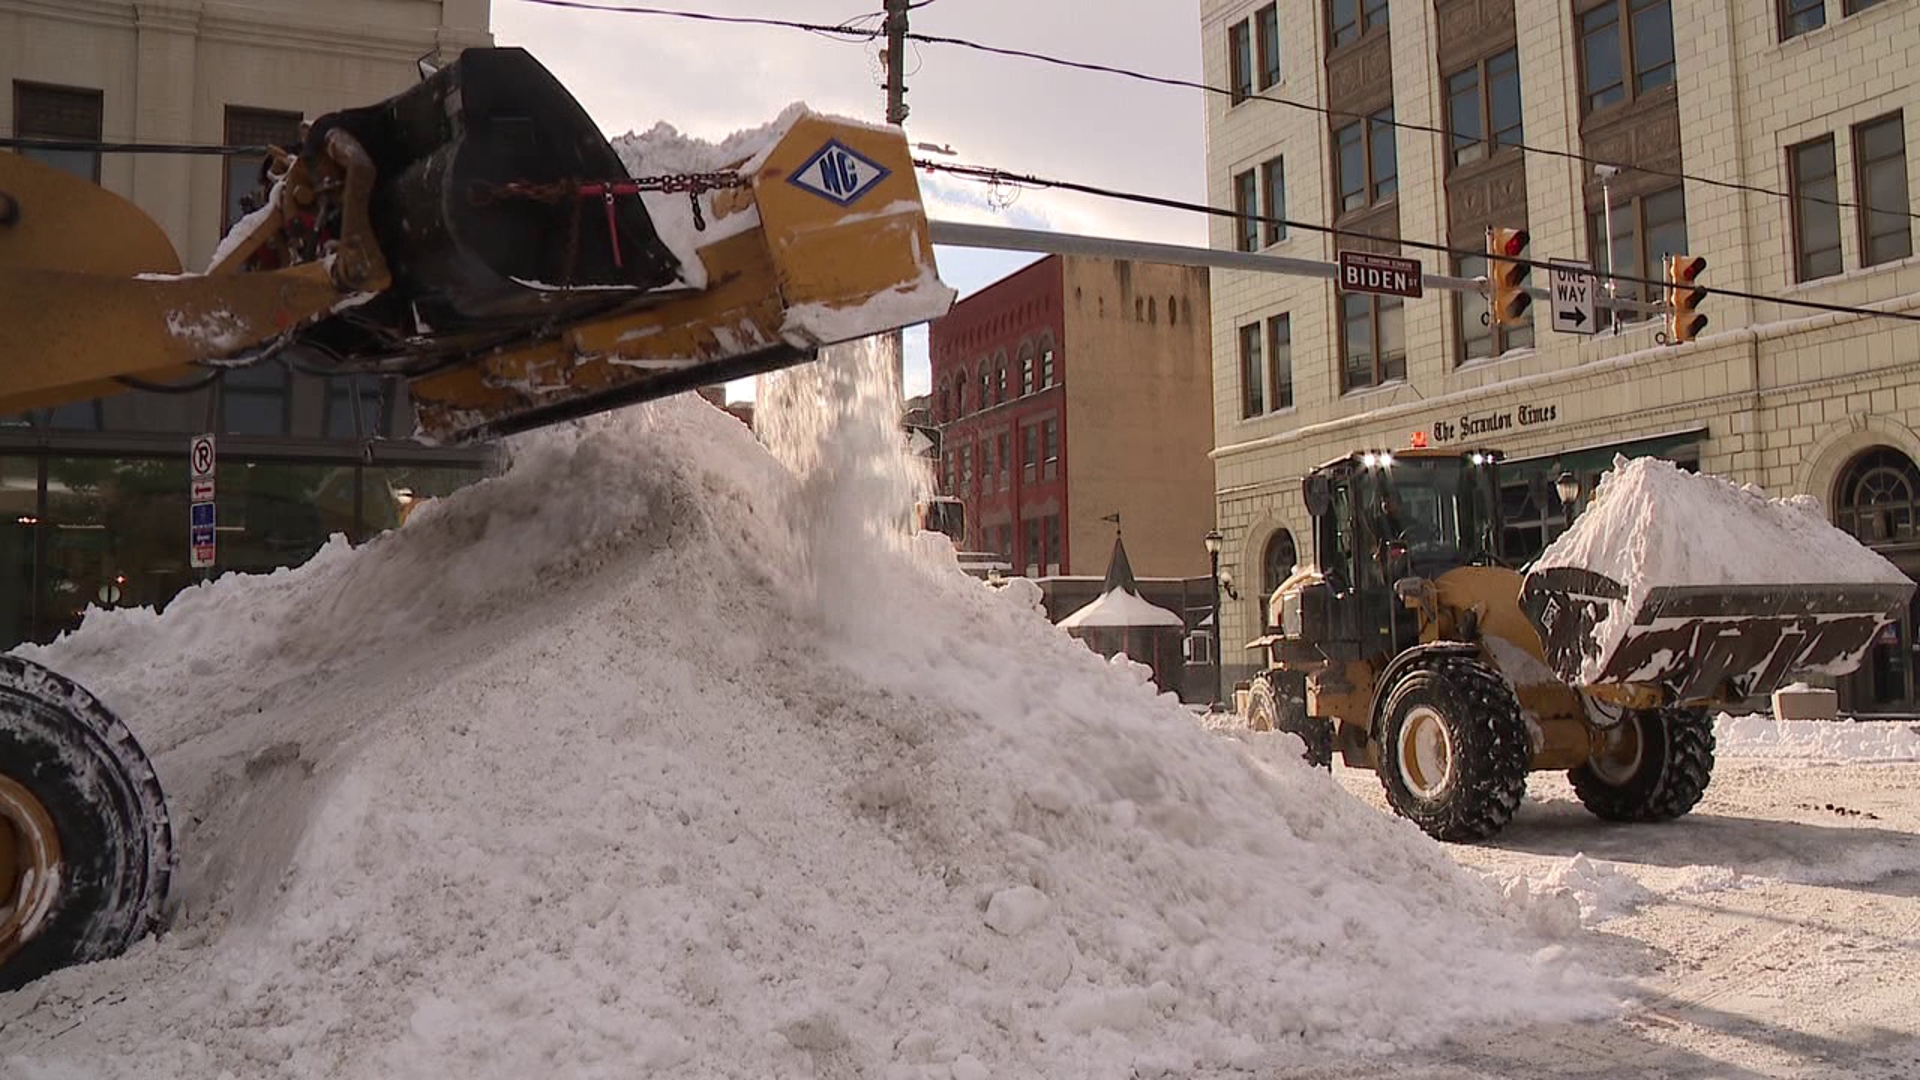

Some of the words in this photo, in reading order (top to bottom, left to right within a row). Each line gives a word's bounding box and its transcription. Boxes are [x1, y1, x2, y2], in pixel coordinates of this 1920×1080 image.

[819, 151, 858, 195] NC
[1347, 266, 1406, 291] BIDEN
[1557, 267, 1585, 283] ONE
[1557, 284, 1586, 303] WAY
[1433, 421, 1455, 442] The
[1459, 412, 1512, 441] Scranton
[1518, 404, 1556, 426] Times
